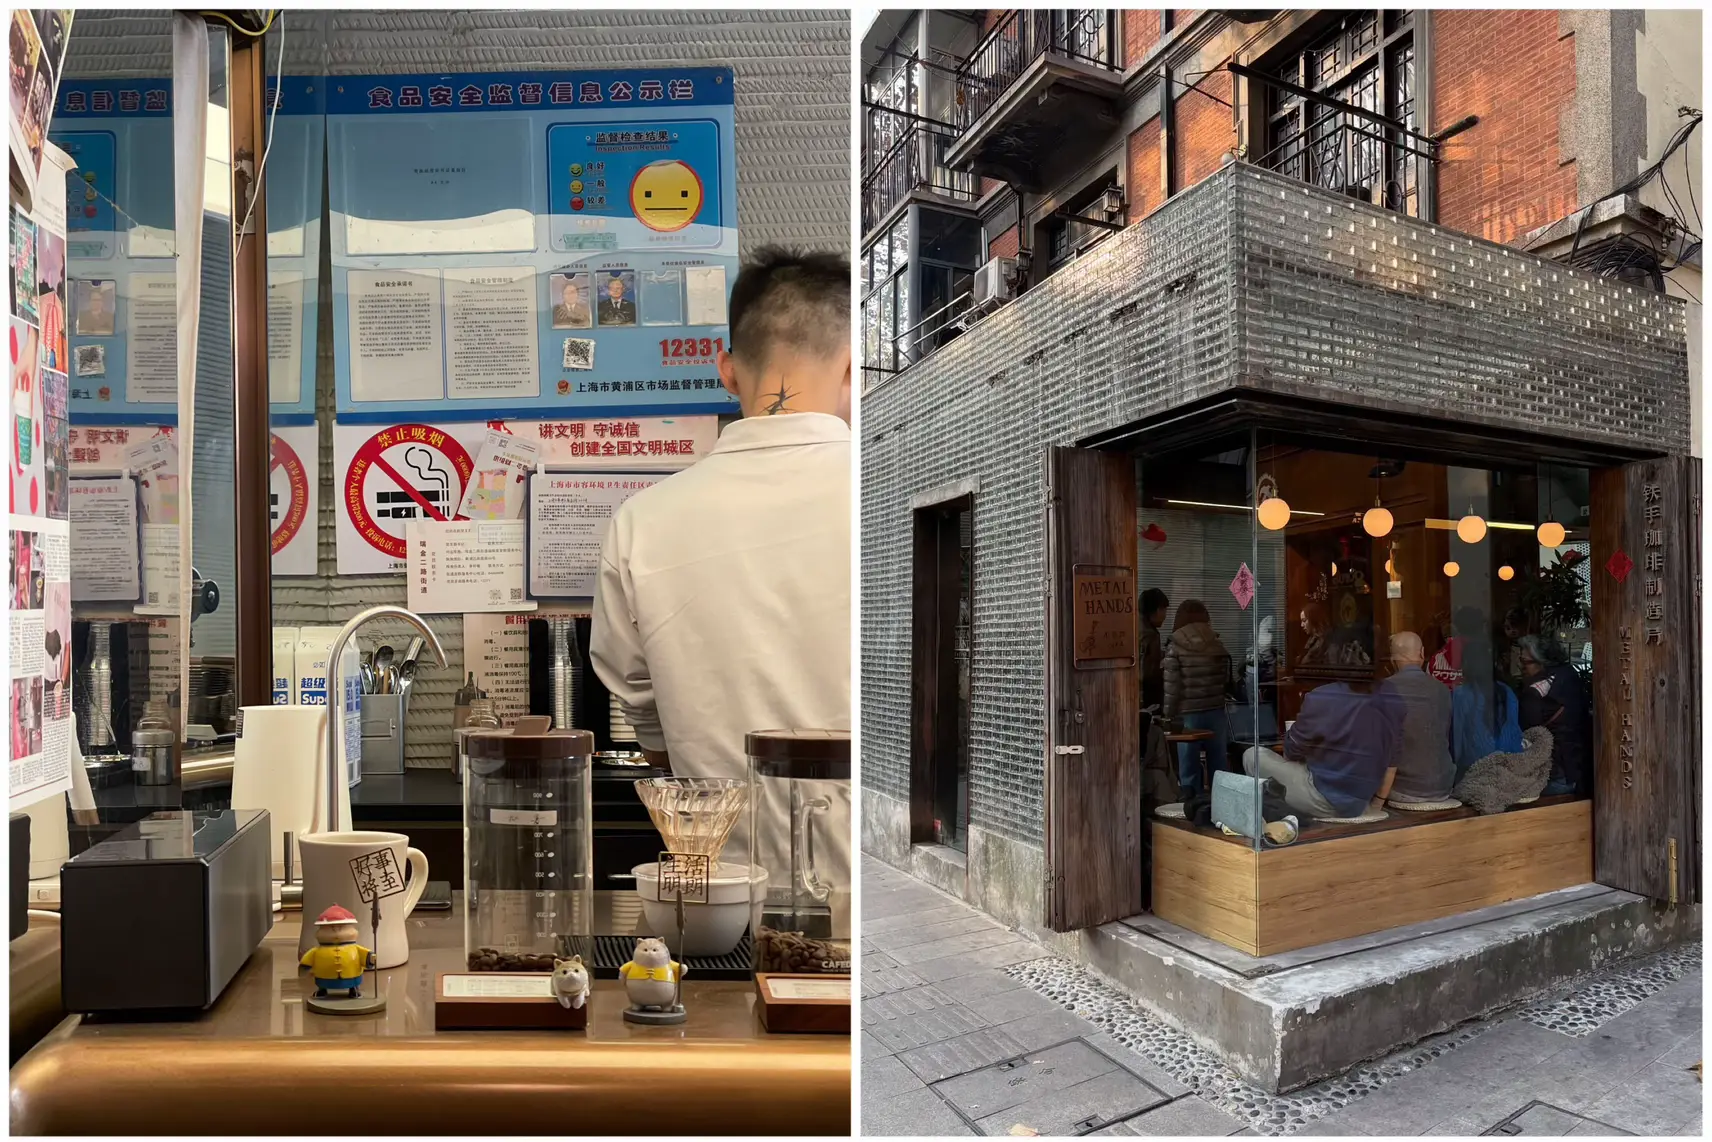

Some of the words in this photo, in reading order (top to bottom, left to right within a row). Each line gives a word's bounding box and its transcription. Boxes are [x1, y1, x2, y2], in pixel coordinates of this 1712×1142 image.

[366, 79, 695, 108] 食品安全监督信息公示栏
[595, 130, 669, 143] 监督检查结果
[586, 162, 605, 171] 良好
[586, 179, 606, 187] 一般
[587, 196, 606, 205] 较差
[659, 337, 724, 358] 12331
[576, 378, 727, 393] 上海市黄浦区市场监督管理局
[377, 427, 446, 449] 禁止吸烟
[538, 422, 585, 439] 讲文明
[593, 421, 641, 438] 守诚信
[569, 439, 695, 457] 创建全国文明城区
[420, 540, 428, 594] 瑞金二路街道
[1079, 581, 1131, 597] METAL
[1084, 597, 1133, 615] HANDS
[1619, 713, 1634, 789] HANDS
[662, 854, 705, 876] 生活
